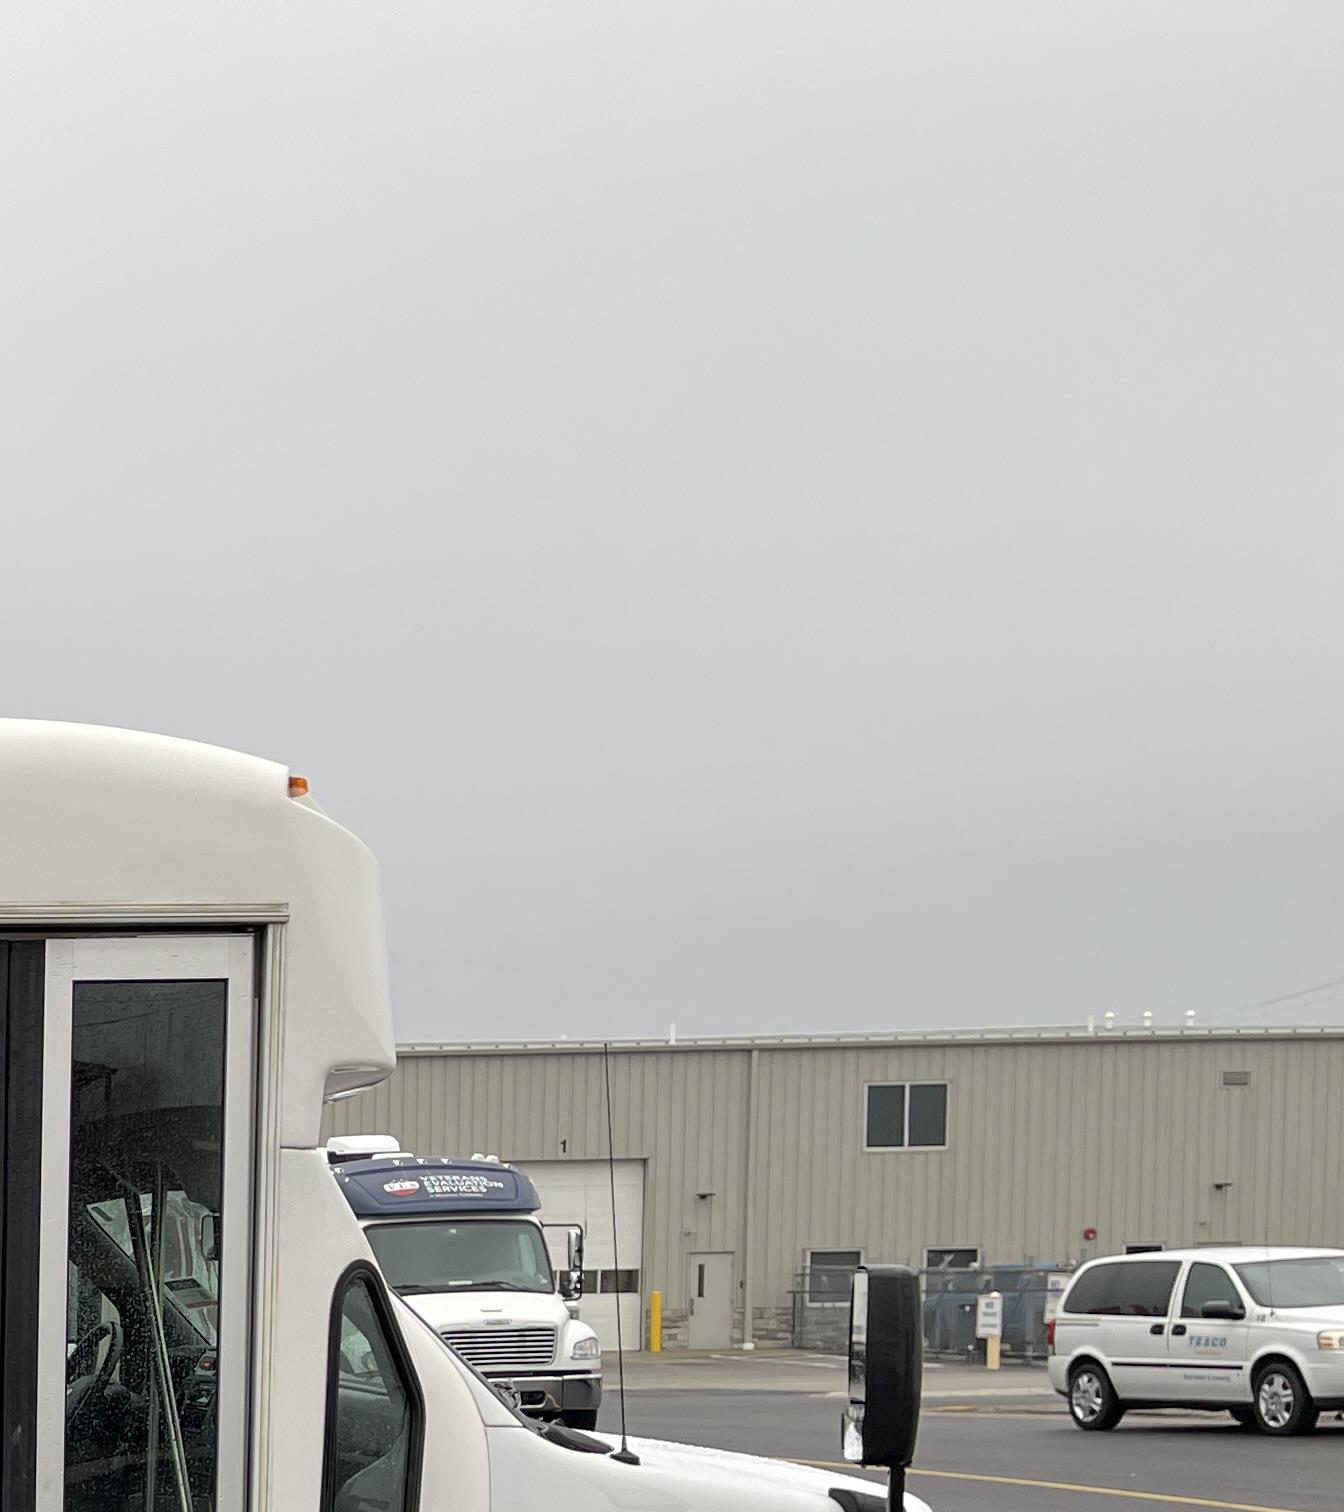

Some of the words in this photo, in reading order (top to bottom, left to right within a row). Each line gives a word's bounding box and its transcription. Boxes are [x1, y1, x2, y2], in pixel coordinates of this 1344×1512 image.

[560, 1139, 567, 1153] 1
[426, 1185, 488, 1193] SERVICES
[1189, 1336, 1227, 1347] TESCO
